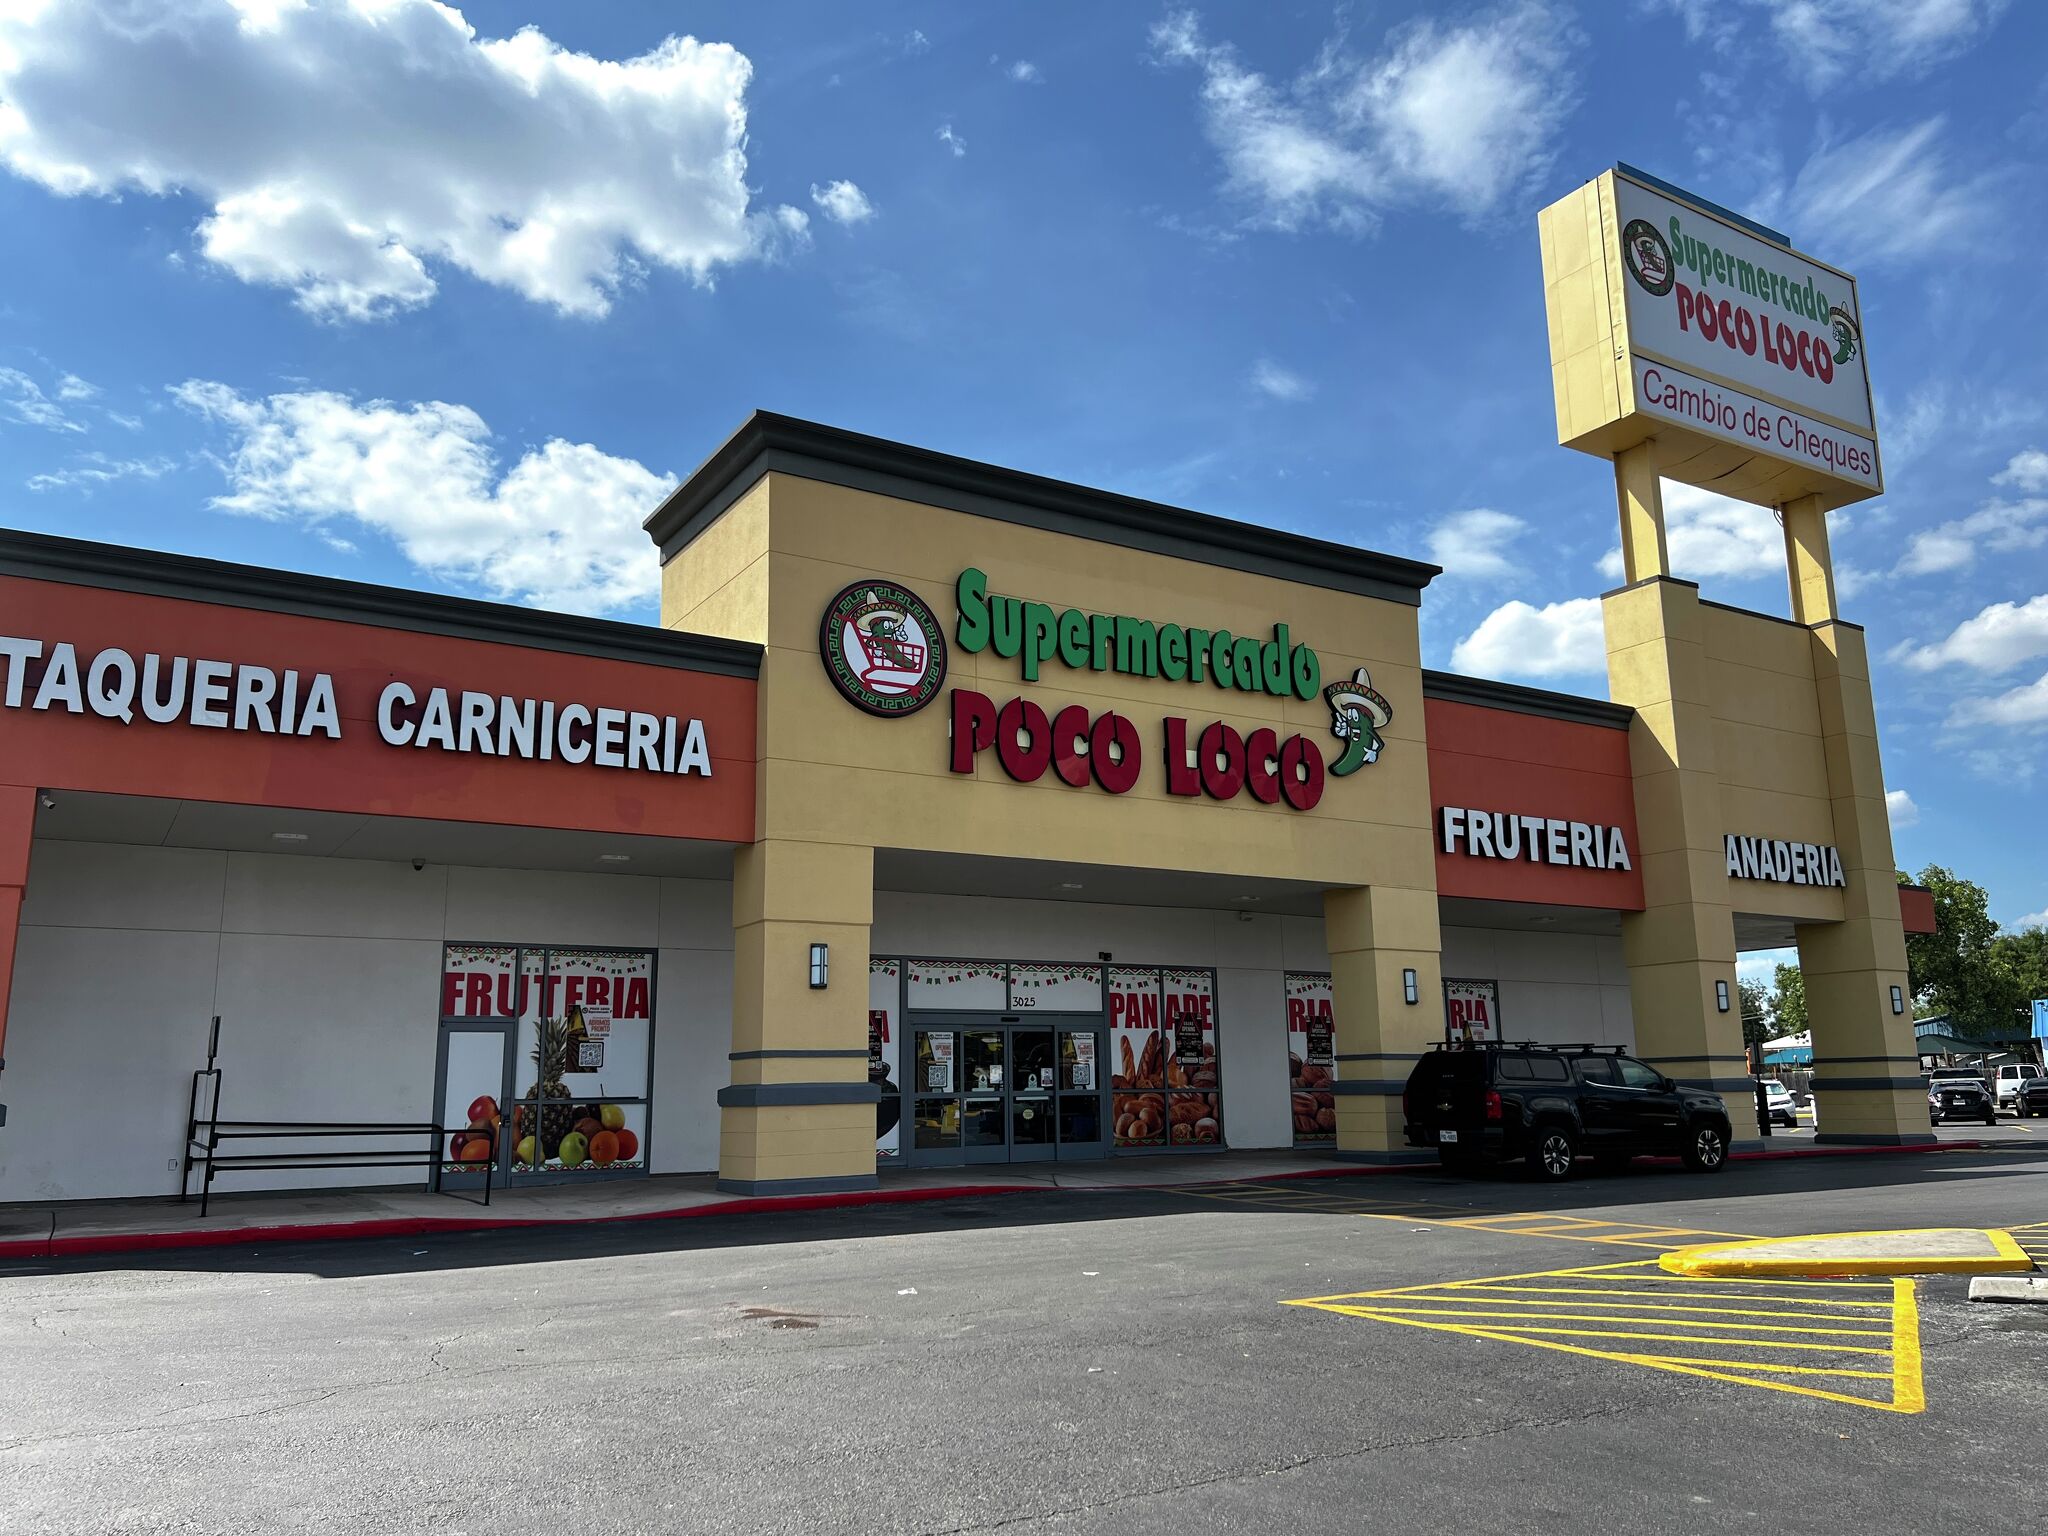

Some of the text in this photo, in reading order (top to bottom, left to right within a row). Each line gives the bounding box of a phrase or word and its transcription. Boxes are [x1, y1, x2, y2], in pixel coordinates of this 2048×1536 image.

[1669, 215, 1830, 326] Supermercado
[1675, 280, 1834, 384] POCO LOCO
[1643, 369, 1872, 475] Cambio de Cheques
[956, 567, 1321, 701] Supermercado
[0, 636, 713, 777] TAQUERIA CARNICERIA
[950, 688, 1325, 811] POCO LOCO
[1441, 806, 1632, 872] FRUTERIA
[1012, 996, 1036, 1007] 3025
